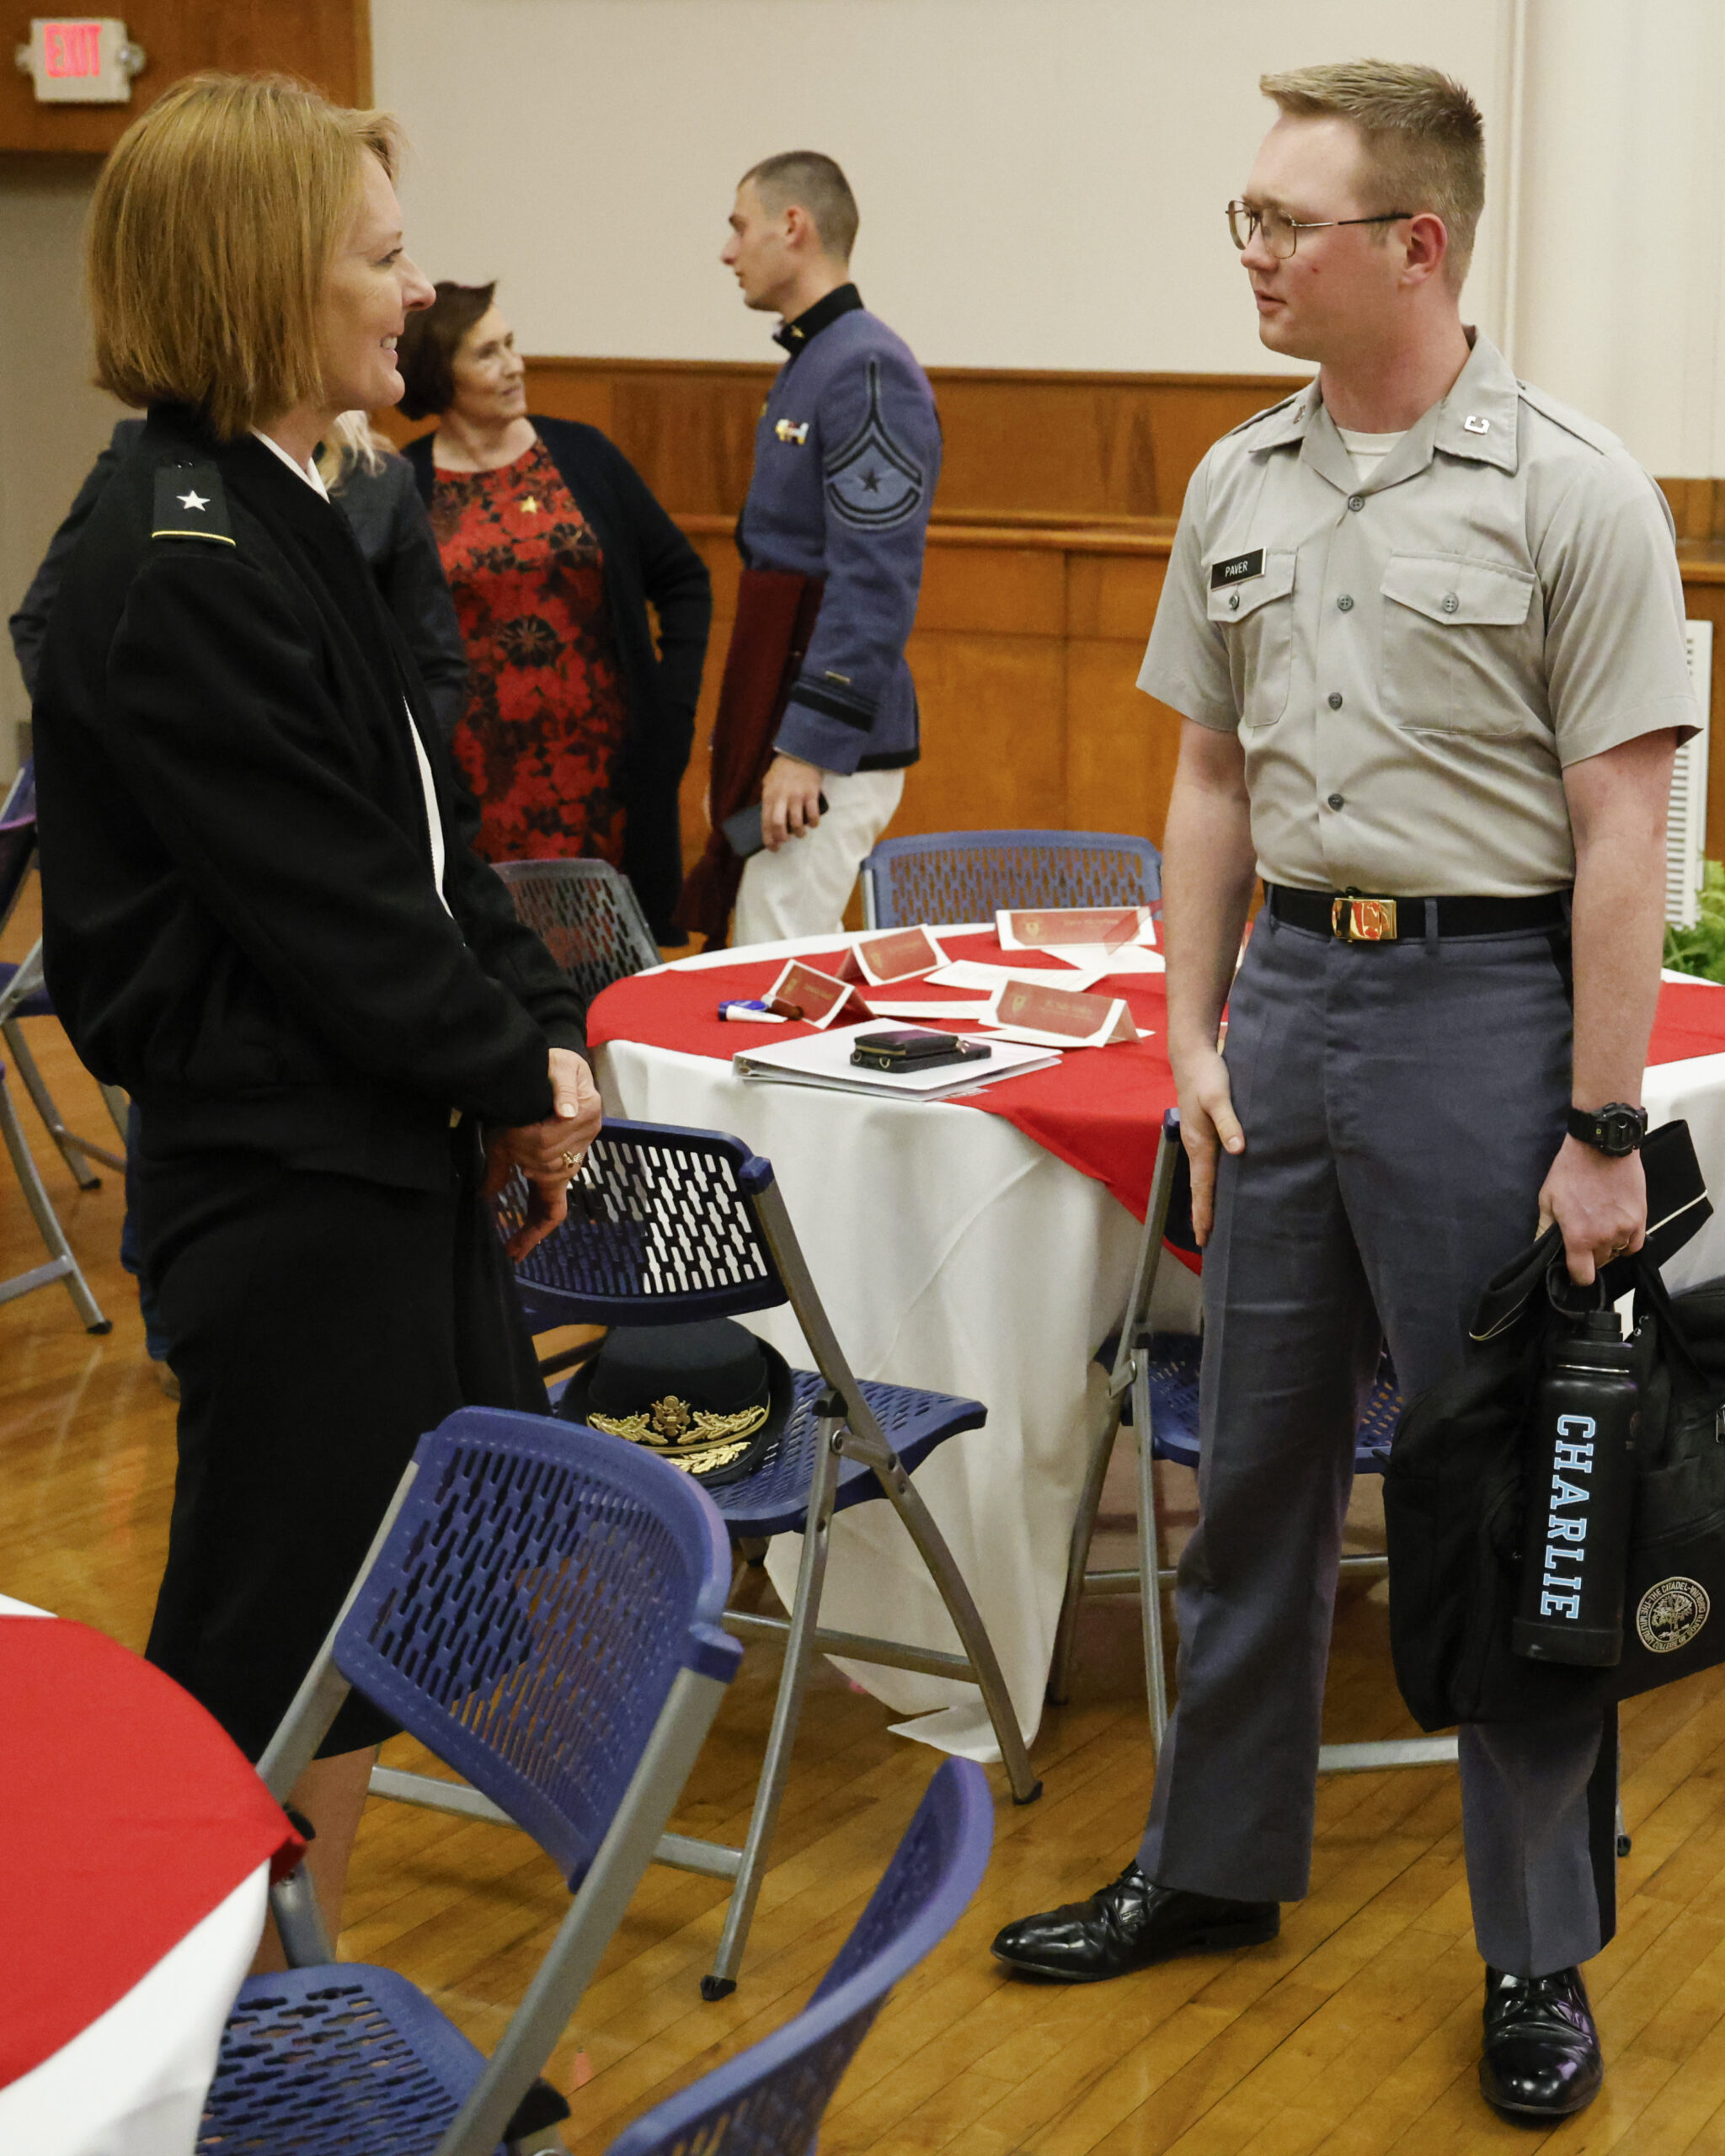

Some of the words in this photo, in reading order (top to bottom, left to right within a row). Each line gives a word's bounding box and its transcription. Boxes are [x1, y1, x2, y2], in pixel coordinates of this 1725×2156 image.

[44, 23, 102, 77] EXIT
[1225, 560, 1248, 578] PAVER
[1541, 1414, 1596, 1619] CHARLIE
